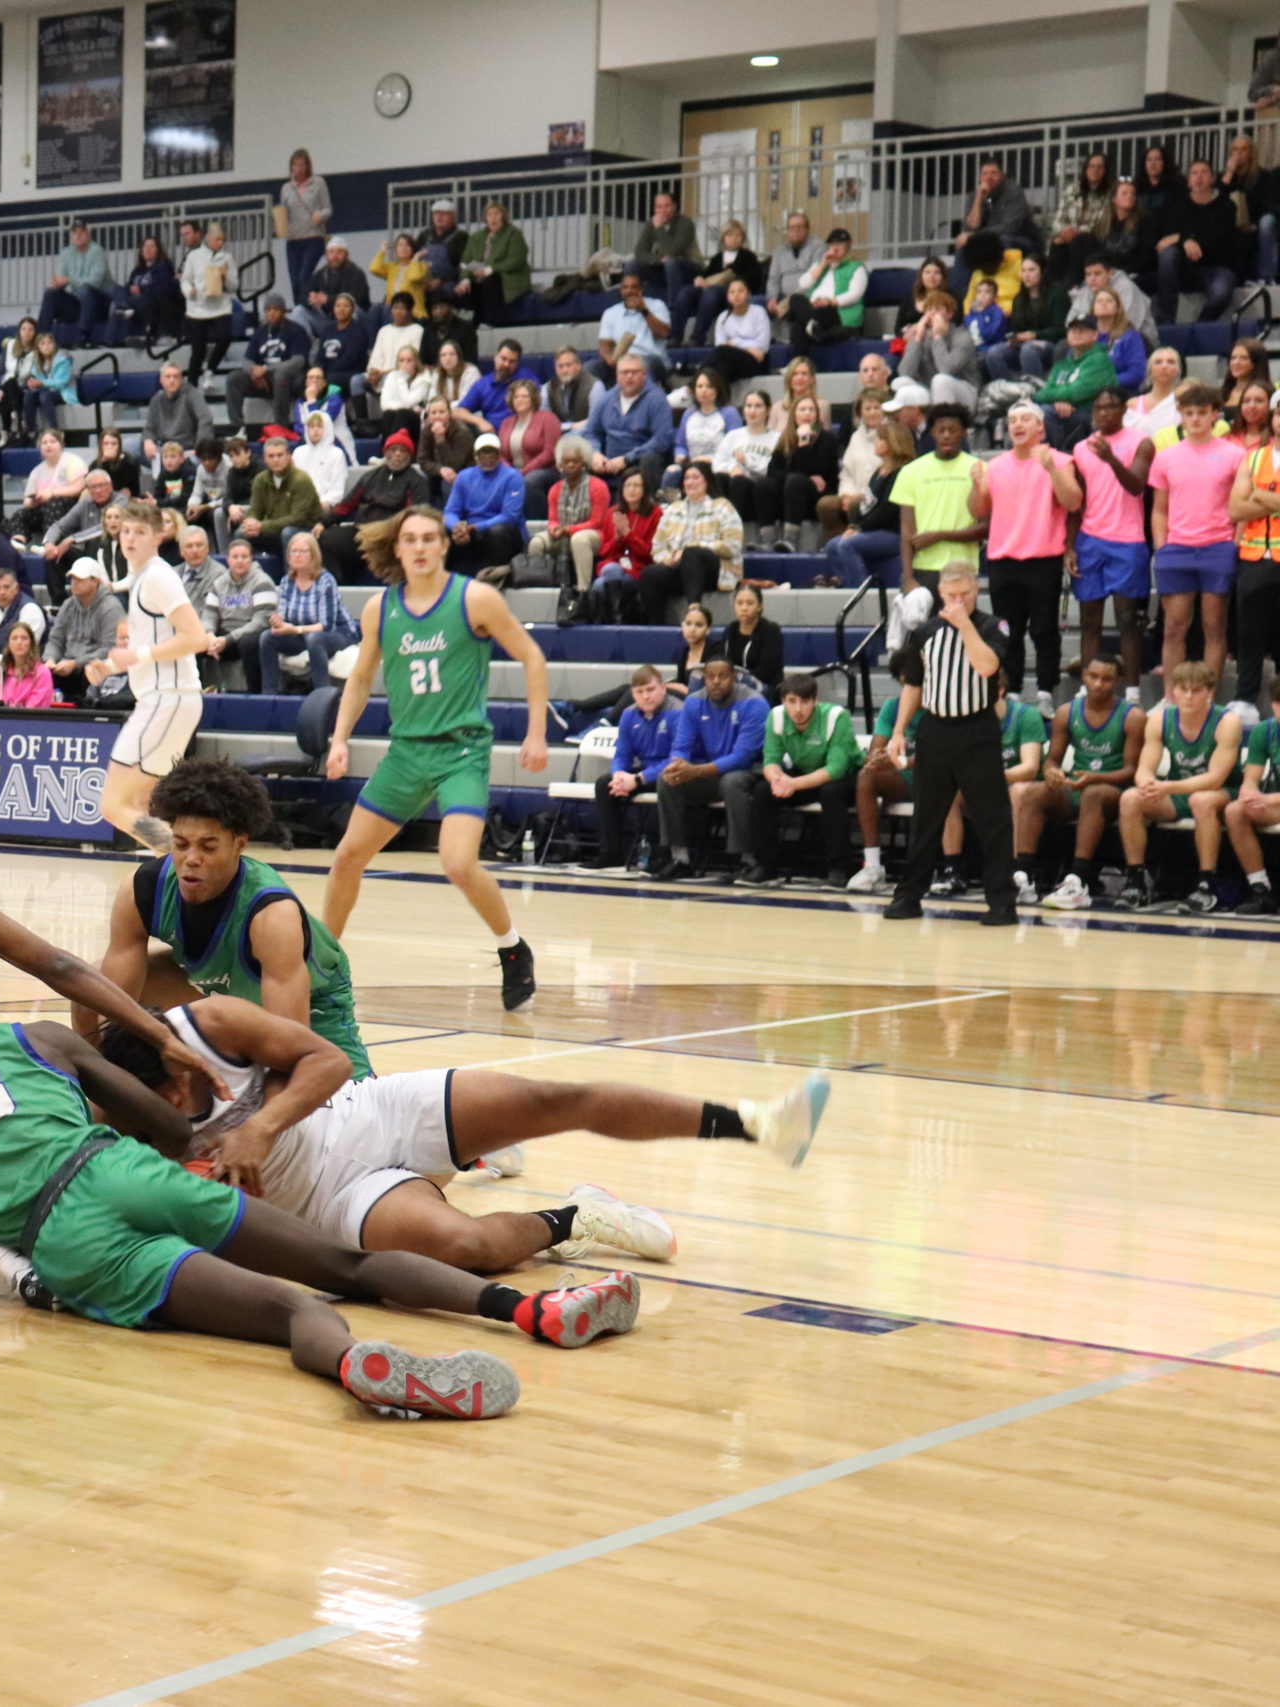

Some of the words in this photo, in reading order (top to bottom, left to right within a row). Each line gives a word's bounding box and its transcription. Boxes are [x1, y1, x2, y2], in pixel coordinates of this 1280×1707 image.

[399, 630, 448, 655] South
[409, 659, 443, 695] 21
[6, 735, 42, 761] OF
[46, 736, 100, 763] THE
